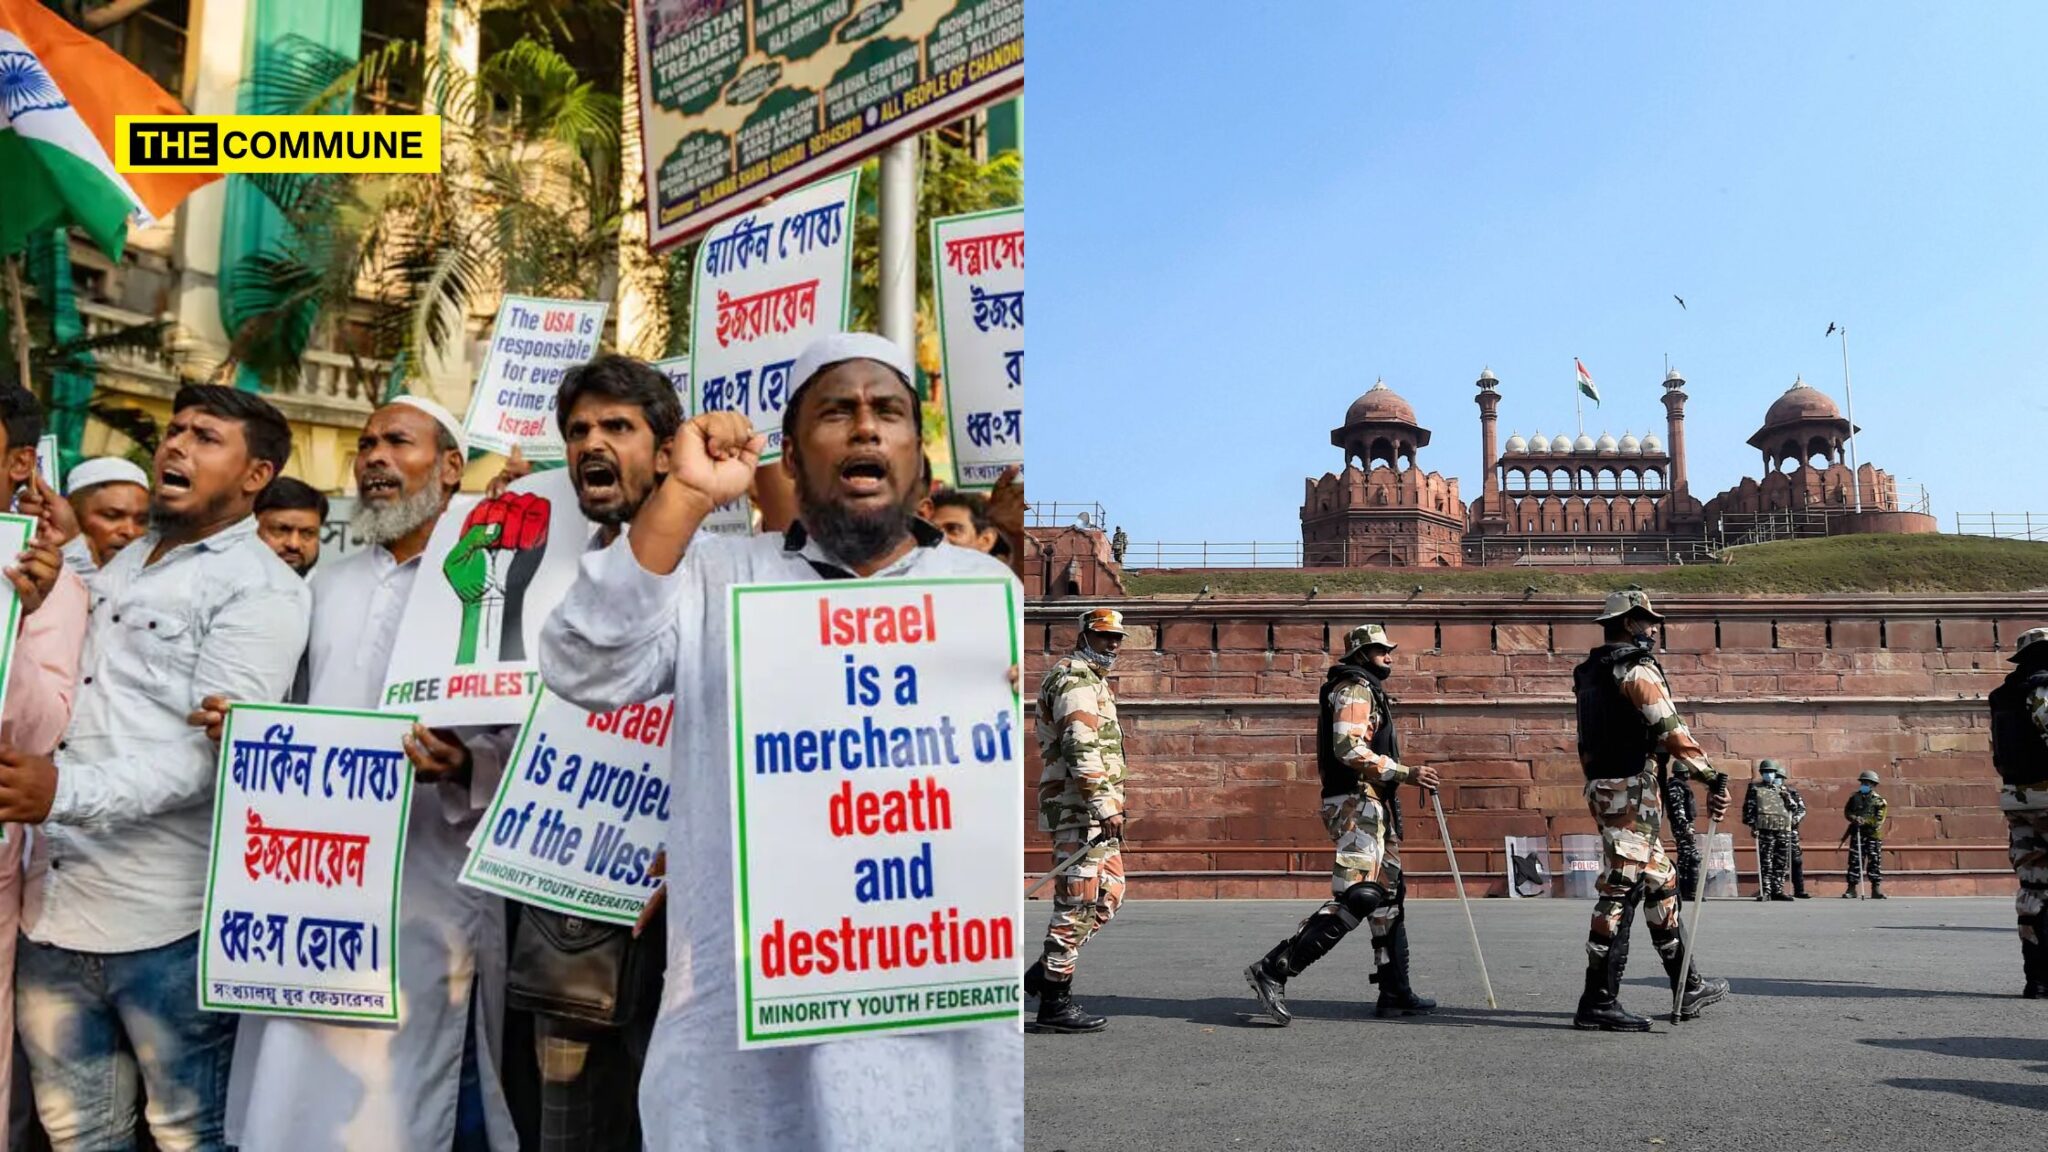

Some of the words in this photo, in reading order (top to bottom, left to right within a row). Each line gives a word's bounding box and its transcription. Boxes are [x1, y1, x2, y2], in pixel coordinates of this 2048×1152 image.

[653, 4, 744, 67] HINDUSTAN
[658, 28, 741, 84] TREADERS
[880, 92, 902, 123] ALL
[903, 74, 949, 111] PEOPLE
[950, 64, 966, 88] OF
[706, 214, 774, 277] মার্কিন
[779, 200, 846, 259] পোষ্য
[511, 307, 539, 332] The
[543, 309, 575, 333] USA
[579, 313, 594, 335] is
[716, 278, 820, 348] ইজরায়েল
[497, 336, 591, 361] responsible
[502, 359, 527, 382] for
[531, 367, 564, 386] ever
[497, 388, 545, 411] crime
[759, 358, 797, 412] হো
[498, 413, 547, 437] Israel.
[967, 410, 1021, 447] ধ্বংস
[819, 594, 936, 646] Israel
[386, 677, 440, 705] FREE
[447, 671, 538, 699] PALEST
[845, 654, 881, 706] is
[894, 665, 917, 705] a
[233, 723, 317, 797] মার্কিন
[323, 747, 404, 802] পোষ্য
[755, 715, 960, 774] merchant
[971, 710, 1012, 763] of
[525, 733, 557, 786] is
[557, 753, 582, 794] a
[578, 759, 670, 822] projec
[493, 800, 537, 849] of
[529, 808, 582, 866] the
[828, 776, 952, 837] death
[244, 806, 370, 888] ইজরায়েল
[854, 842, 933, 904] and
[1572, 861, 1598, 870] POLICE
[477, 858, 535, 887] MINORITY
[536, 875, 576, 900] YOUTH
[220, 909, 288, 966] ধ্বংস
[761, 908, 1013, 979] destruction
[759, 999, 851, 1025] MINORITY
[857, 992, 920, 1016] YOUTH
[926, 985, 1019, 1011] FEDERATIO
